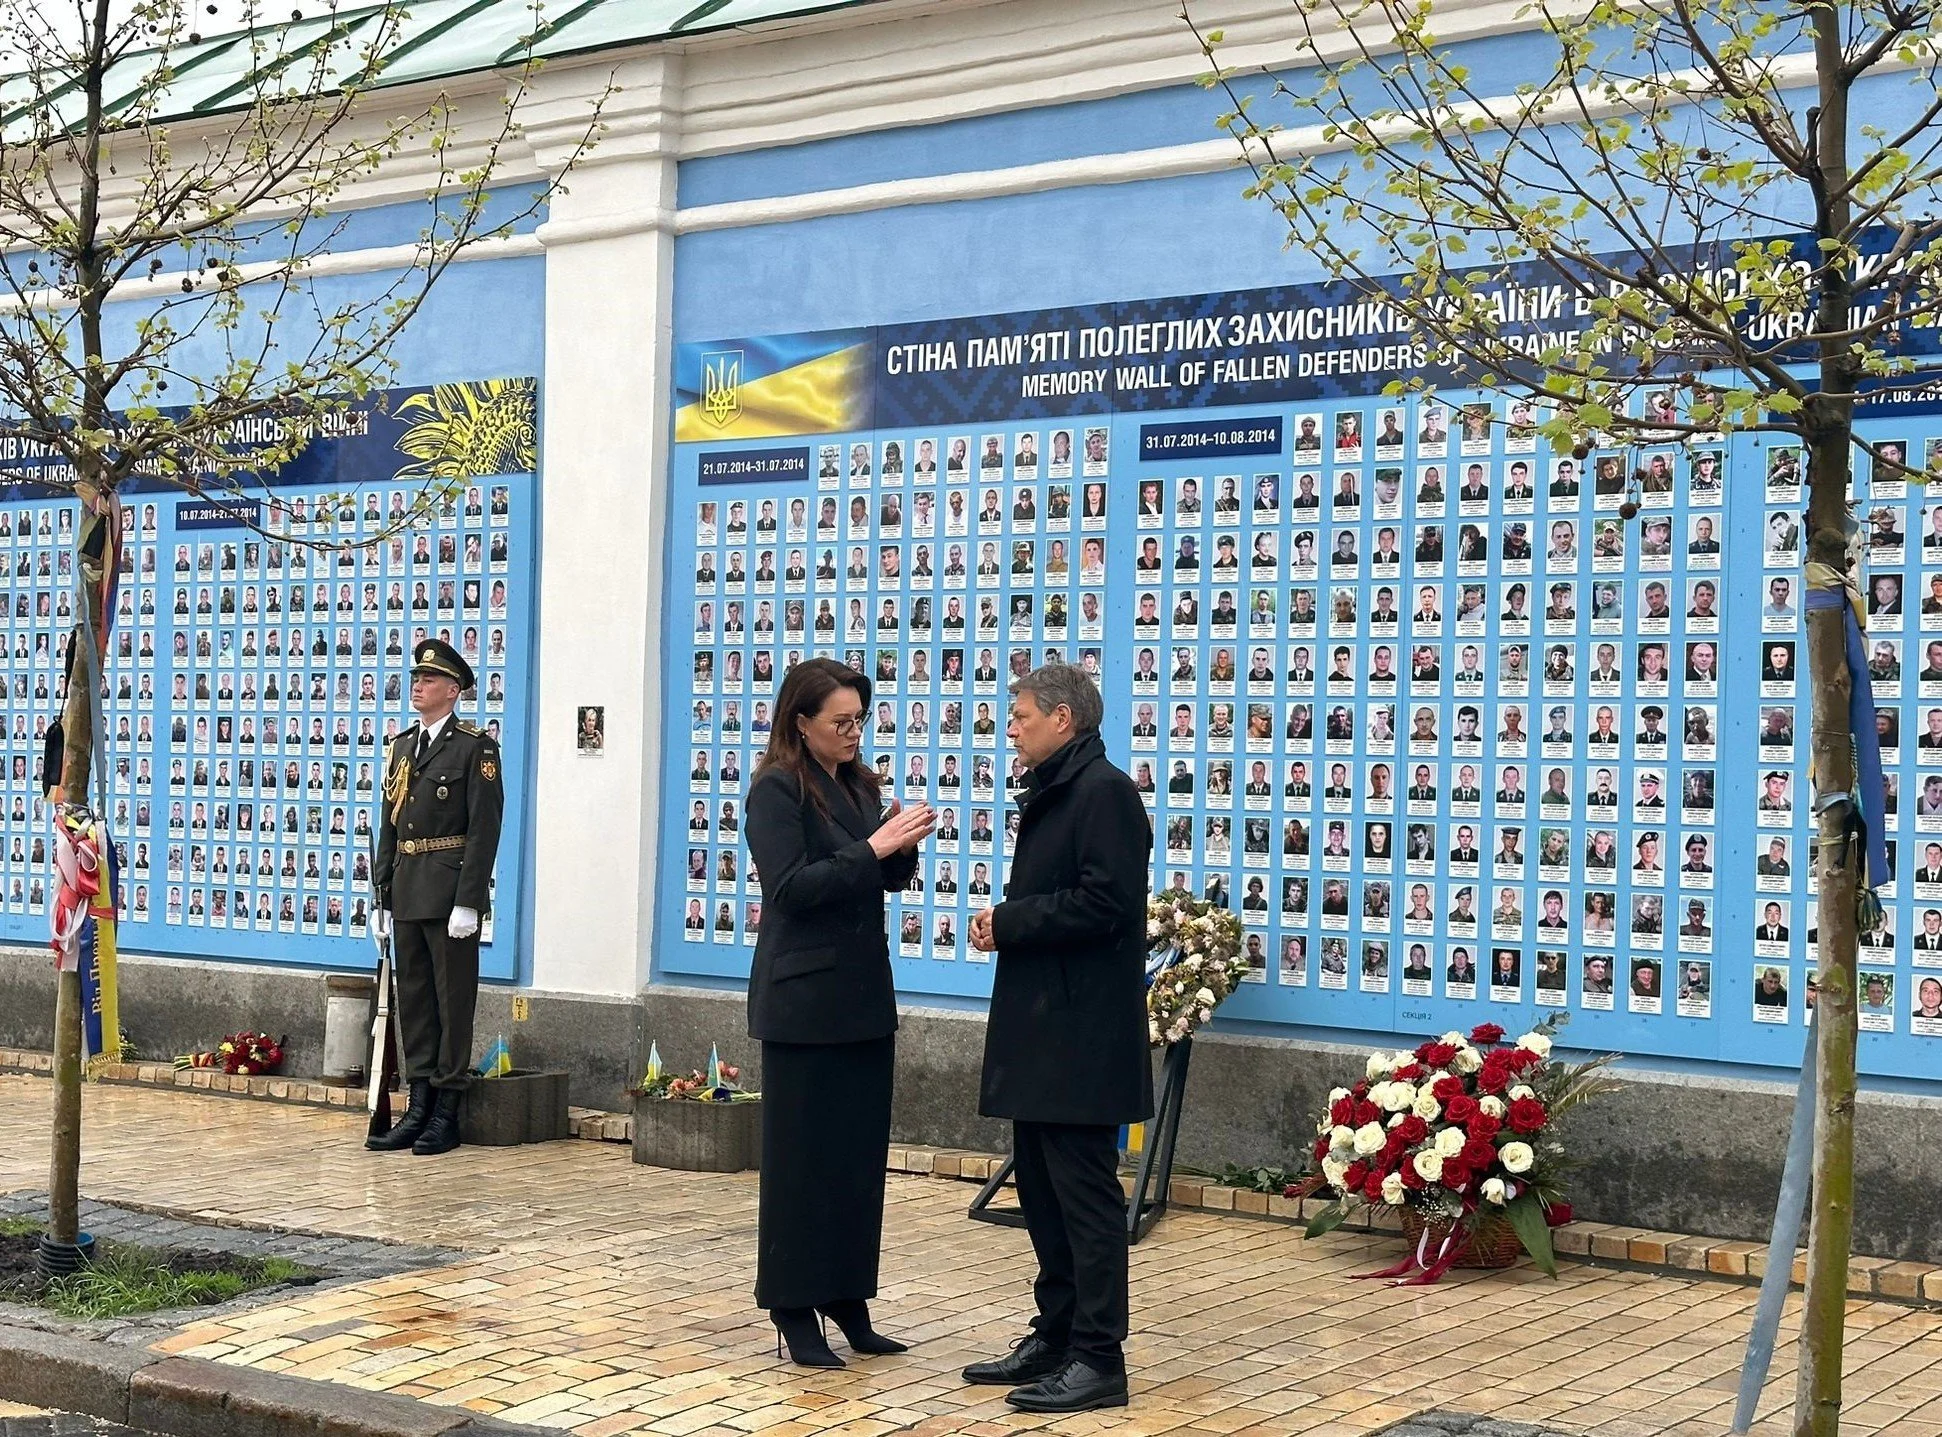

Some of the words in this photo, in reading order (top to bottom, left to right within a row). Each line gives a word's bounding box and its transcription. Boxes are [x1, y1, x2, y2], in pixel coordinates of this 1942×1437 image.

[887, 341, 958, 375] СТІНА
[966, 330, 1070, 369] ПАМ’ЯТІ
[1079, 315, 1223, 359] ПОЛЕГЛИХ
[1022, 369, 1107, 398] MEMORY
[1115, 361, 1171, 390] WALL
[1179, 361, 1206, 387] OF
[1213, 353, 1291, 385] FALLEN
[1298, 342, 1429, 378] DEFENDERS
[0, 437, 17, 460] ІВ
[1145, 428, 1276, 450] 31.07.2014–10.08.2014
[703, 457, 805, 475] 21.07.2014–31.07.2014
